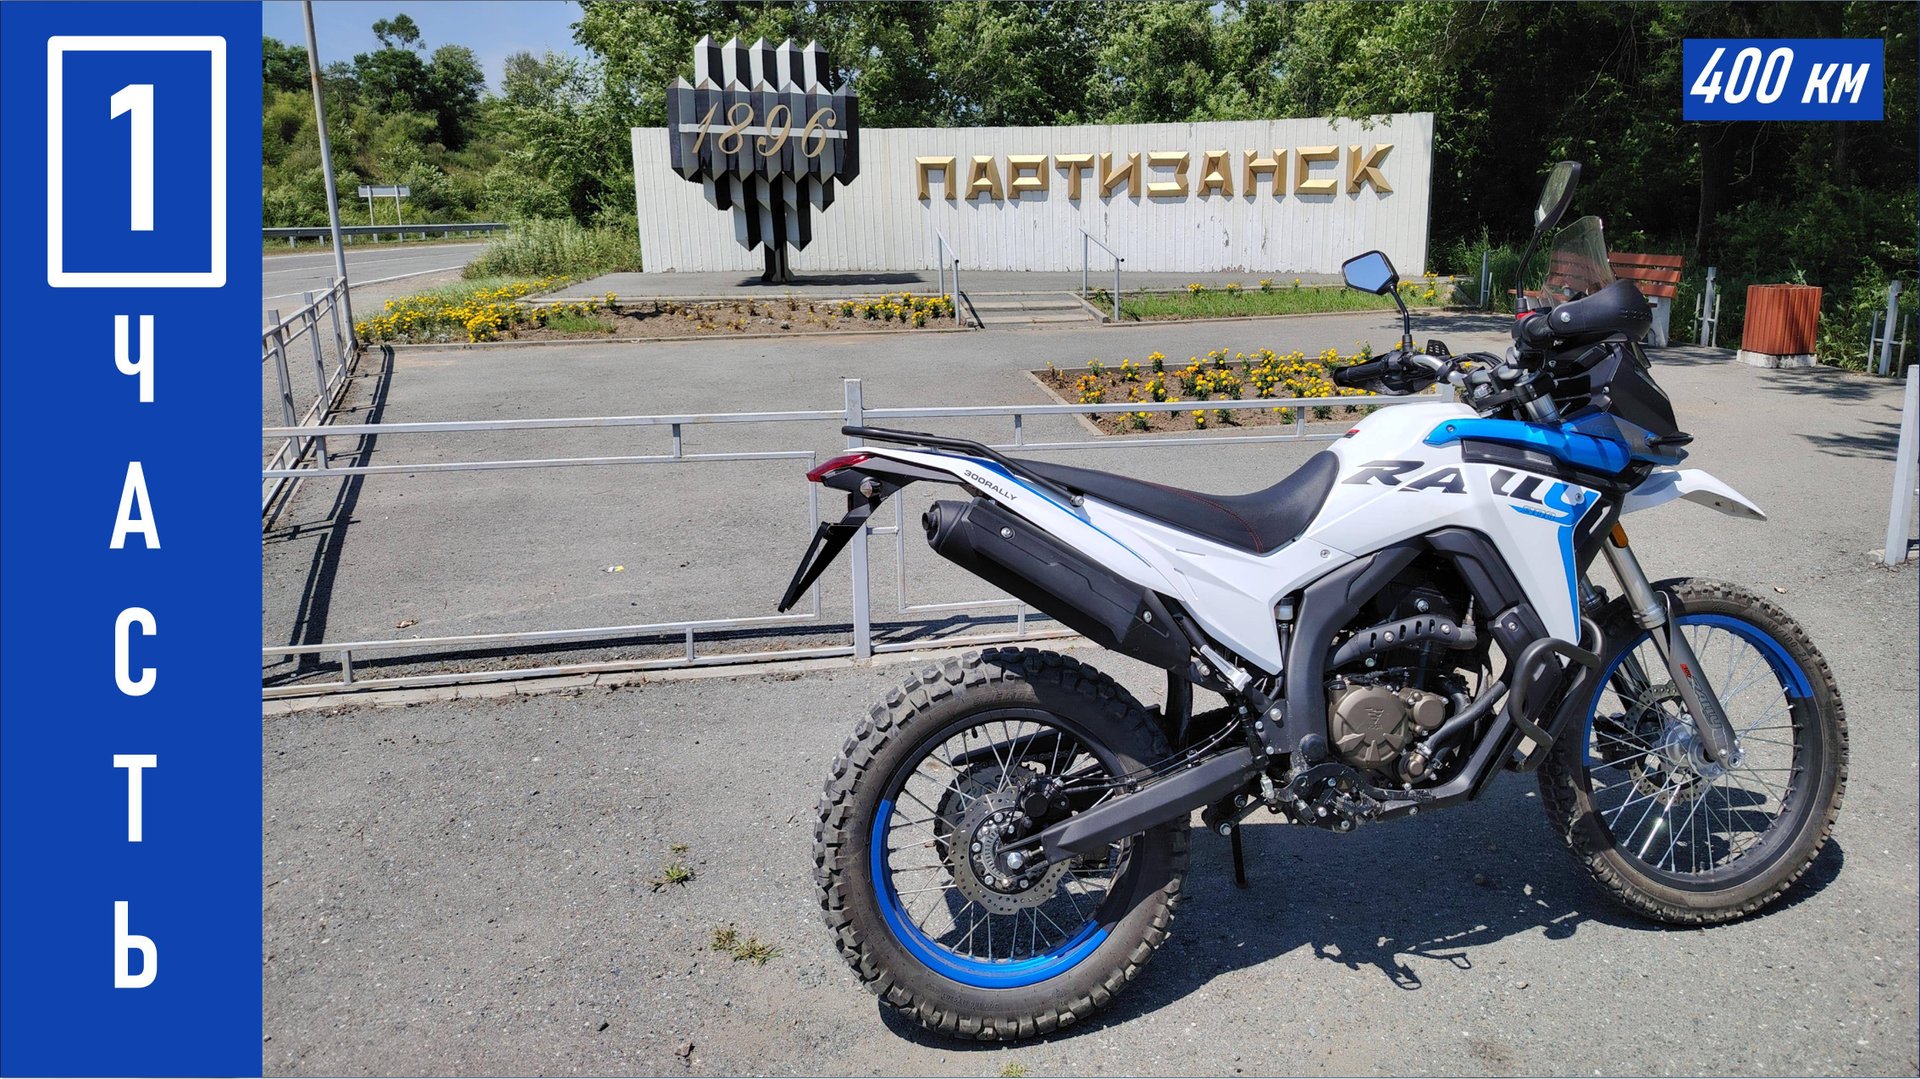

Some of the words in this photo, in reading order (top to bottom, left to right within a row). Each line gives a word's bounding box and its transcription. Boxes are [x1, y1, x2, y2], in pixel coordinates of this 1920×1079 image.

[692, 102, 837, 158] 1896
[916, 143, 1395, 201] ПАРТИЗАНСК
[964, 469, 1018, 501] 300RALLY
